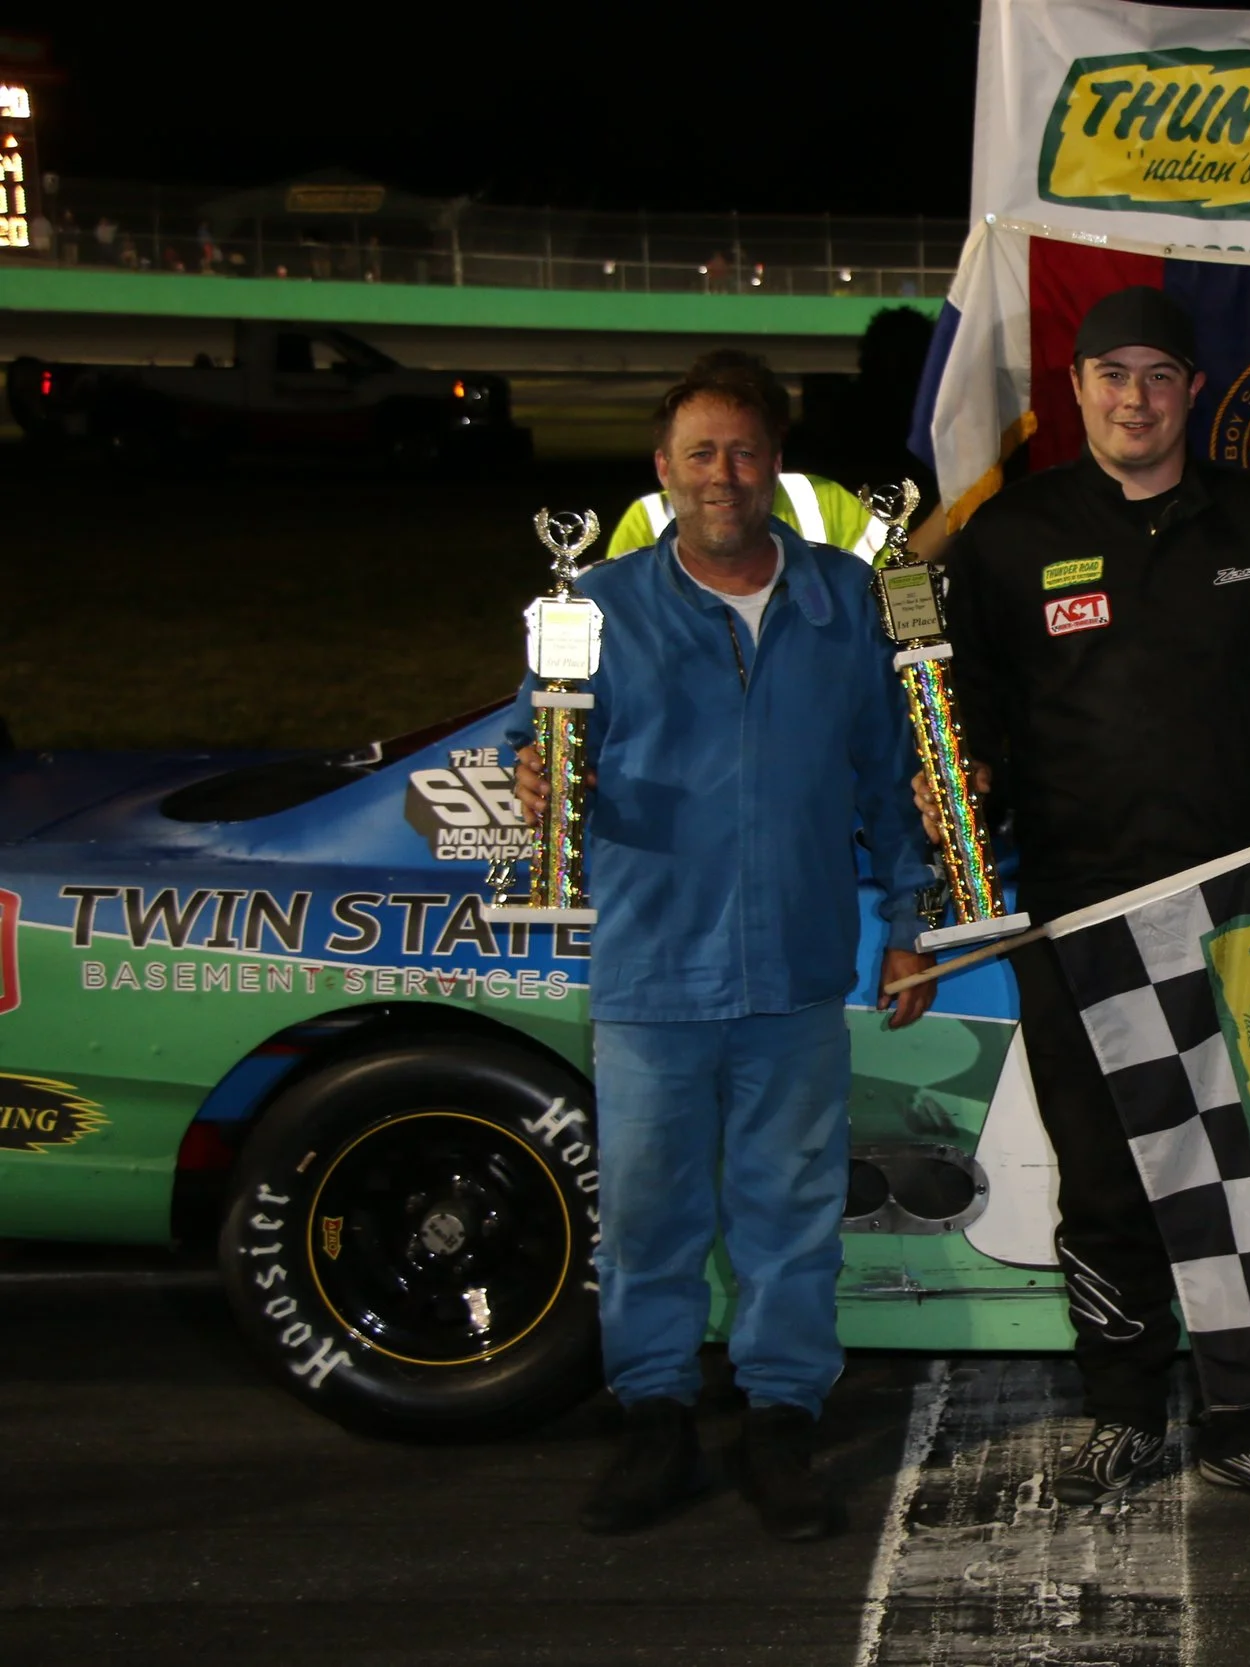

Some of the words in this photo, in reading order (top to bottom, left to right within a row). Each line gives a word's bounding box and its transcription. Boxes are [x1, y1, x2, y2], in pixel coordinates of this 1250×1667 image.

[1224, 412, 1245, 460] BOY
[1046, 564, 1078, 579] THUNDER
[1079, 560, 1100, 573] ROAD
[896, 620, 910, 630] 1st
[912, 616, 937, 628] Place
[1051, 595, 1104, 627] ACT
[450, 747, 499, 767] THE
[438, 828, 534, 846] MONUM
[436, 846, 533, 861] COMPA
[61, 885, 312, 952] TWIN
[325, 891, 591, 960] STATE
[82, 960, 323, 993] BASEMENT
[343, 965, 570, 999] SERVICES
[0, 1106, 59, 1133] ING
[328, 1221, 338, 1252] AERO
[238, 1182, 354, 1389] Hoosier
